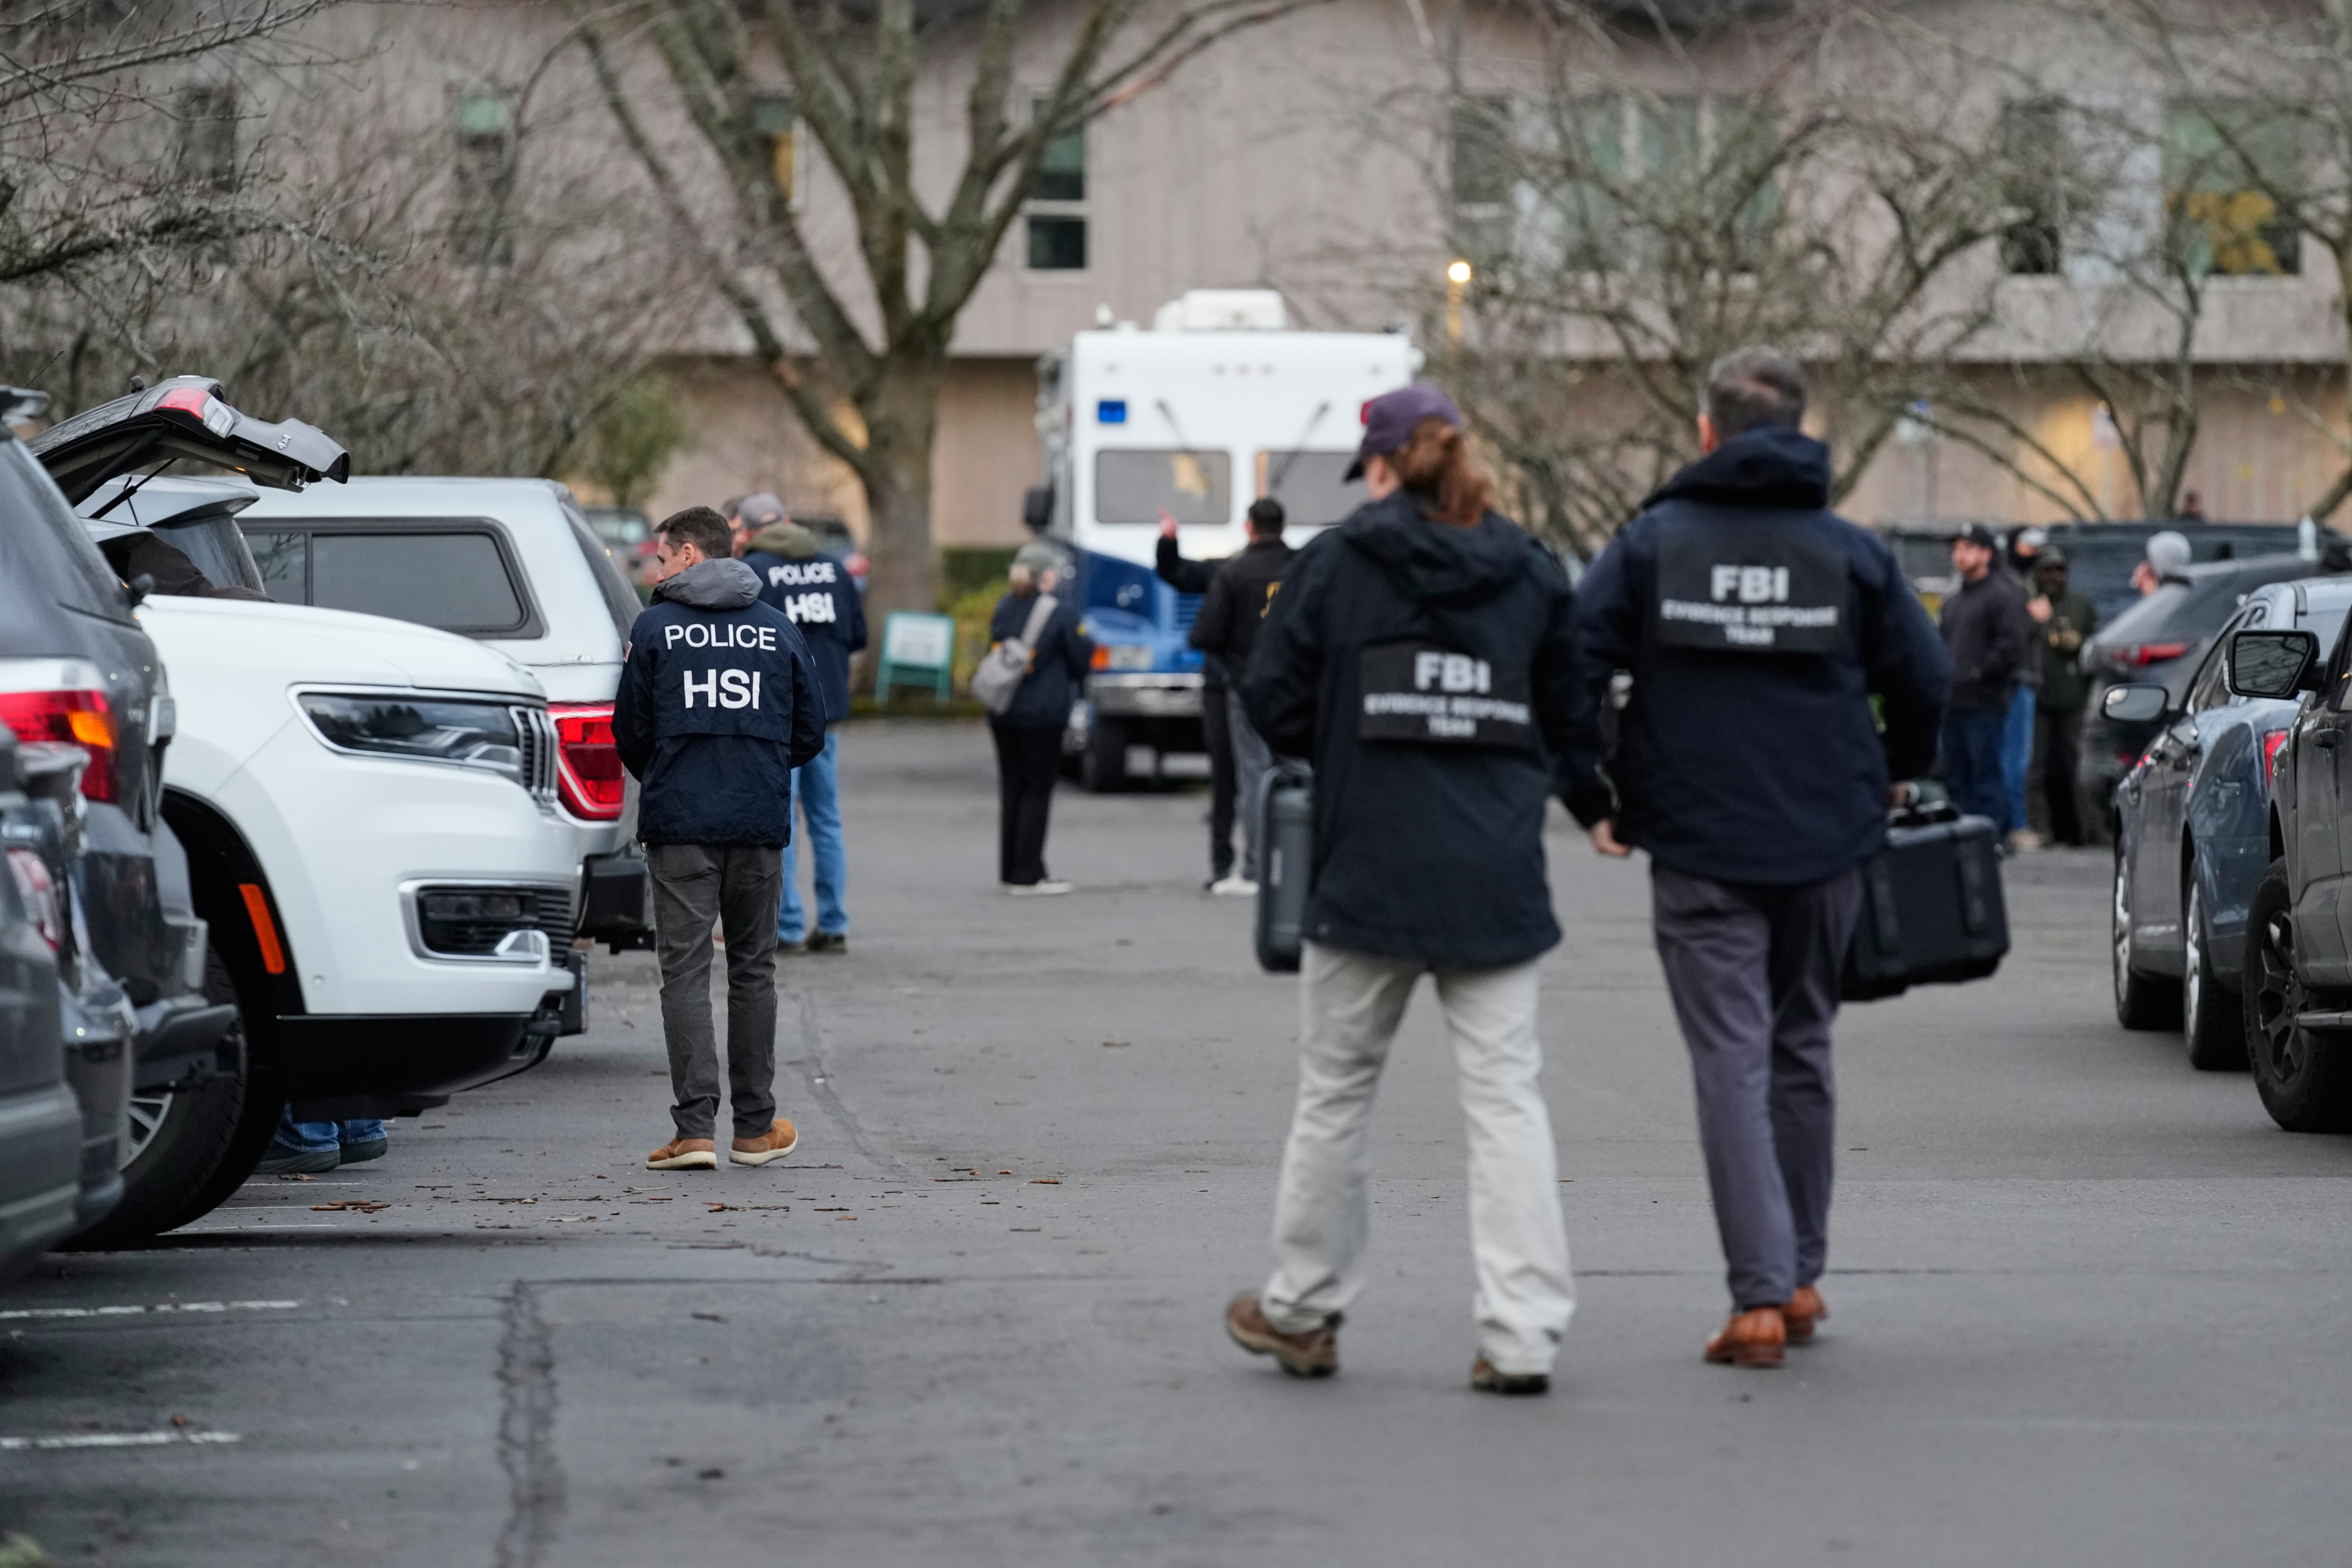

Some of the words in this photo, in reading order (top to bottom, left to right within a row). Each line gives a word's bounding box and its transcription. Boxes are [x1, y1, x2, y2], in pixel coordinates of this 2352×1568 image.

[768, 561, 837, 587] POLICE
[1711, 564, 1790, 603] FBI
[785, 592, 837, 624] HSI
[664, 623, 776, 651] POLICE
[683, 669, 760, 710] HSI
[1414, 651, 1491, 694] FBI
